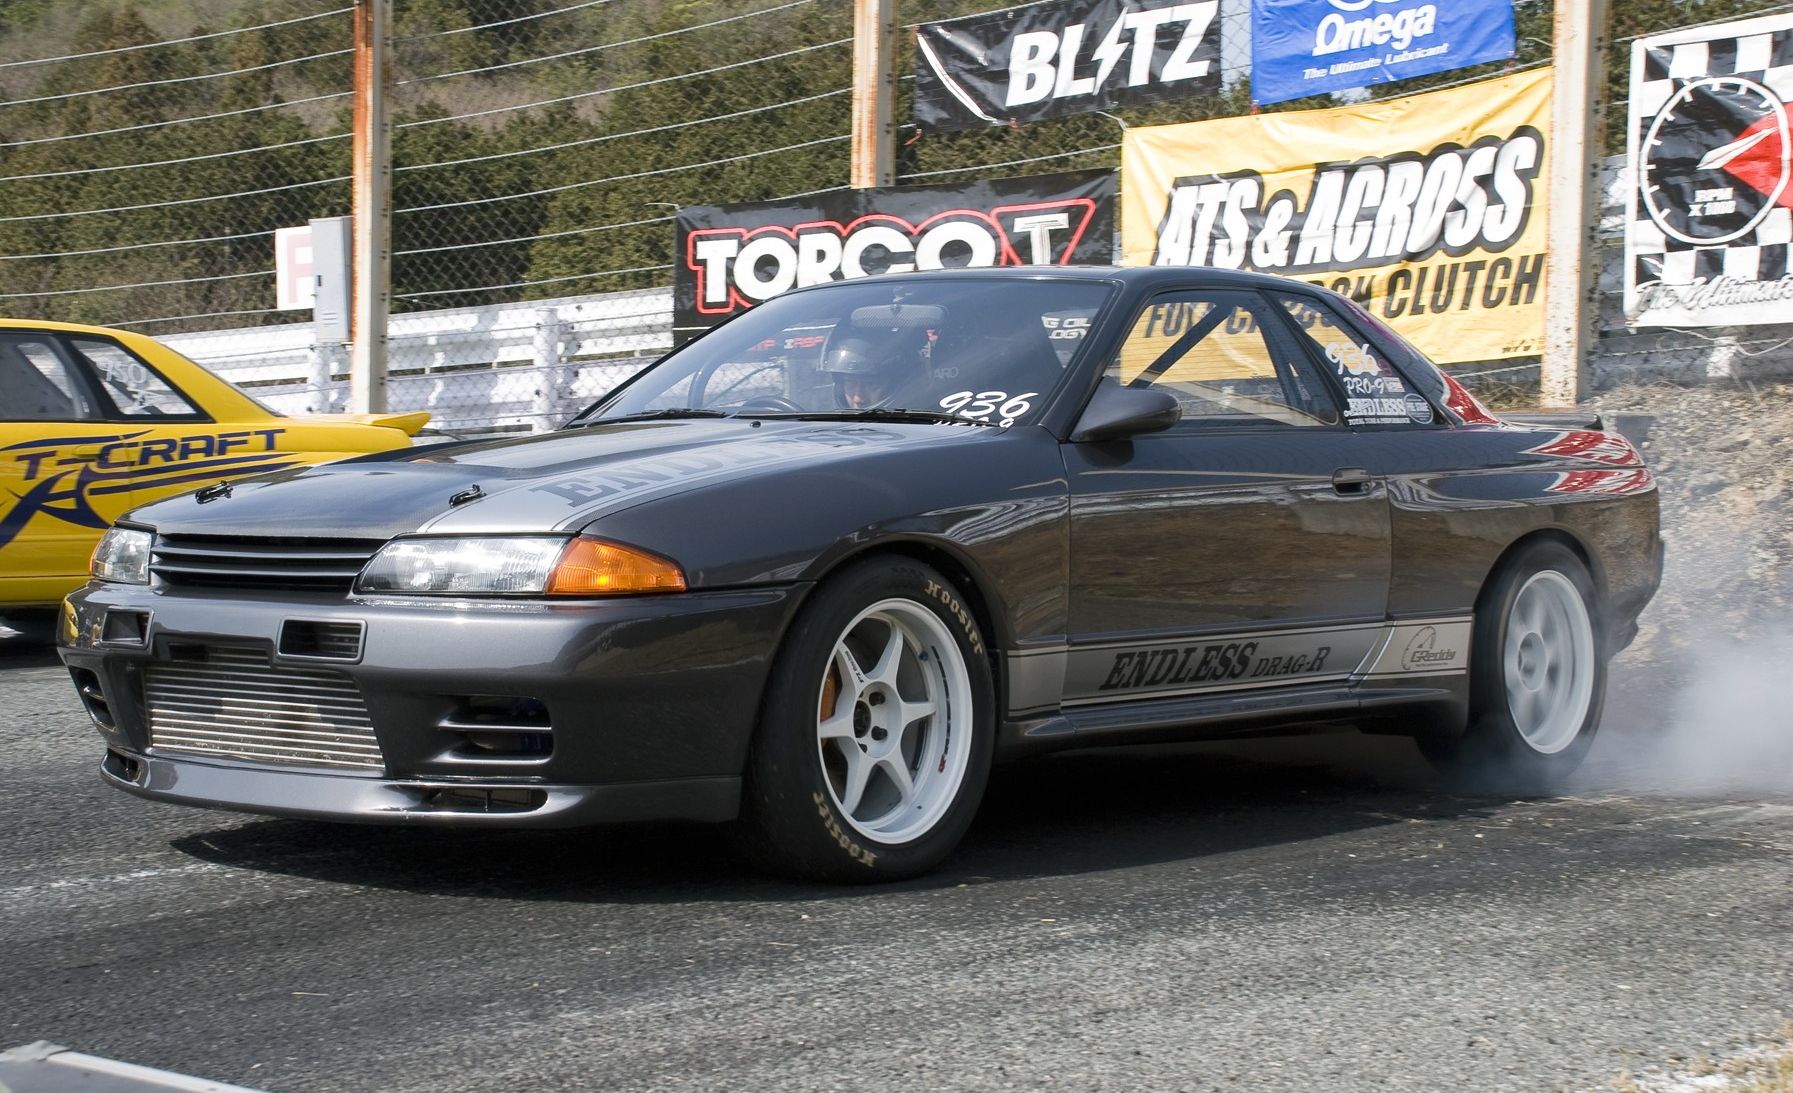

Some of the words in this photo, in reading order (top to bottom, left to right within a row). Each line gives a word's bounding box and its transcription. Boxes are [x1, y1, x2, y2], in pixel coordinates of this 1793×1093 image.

[1005, 0, 1219, 107] BLITZ
[1311, 4, 1437, 57] Omega
[1303, 68, 1328, 80] The
[1329, 57, 1382, 76] Ultimate
[1384, 43, 1449, 65] Lubricant
[695, 220, 997, 304] TORCO
[1384, 253, 1546, 319] CLUTCH
[1325, 343, 1382, 376] 936
[939, 390, 1039, 418] 936
[16, 428, 286, 481] T-CRAFT
[1098, 642, 1260, 691] ENDLESS
